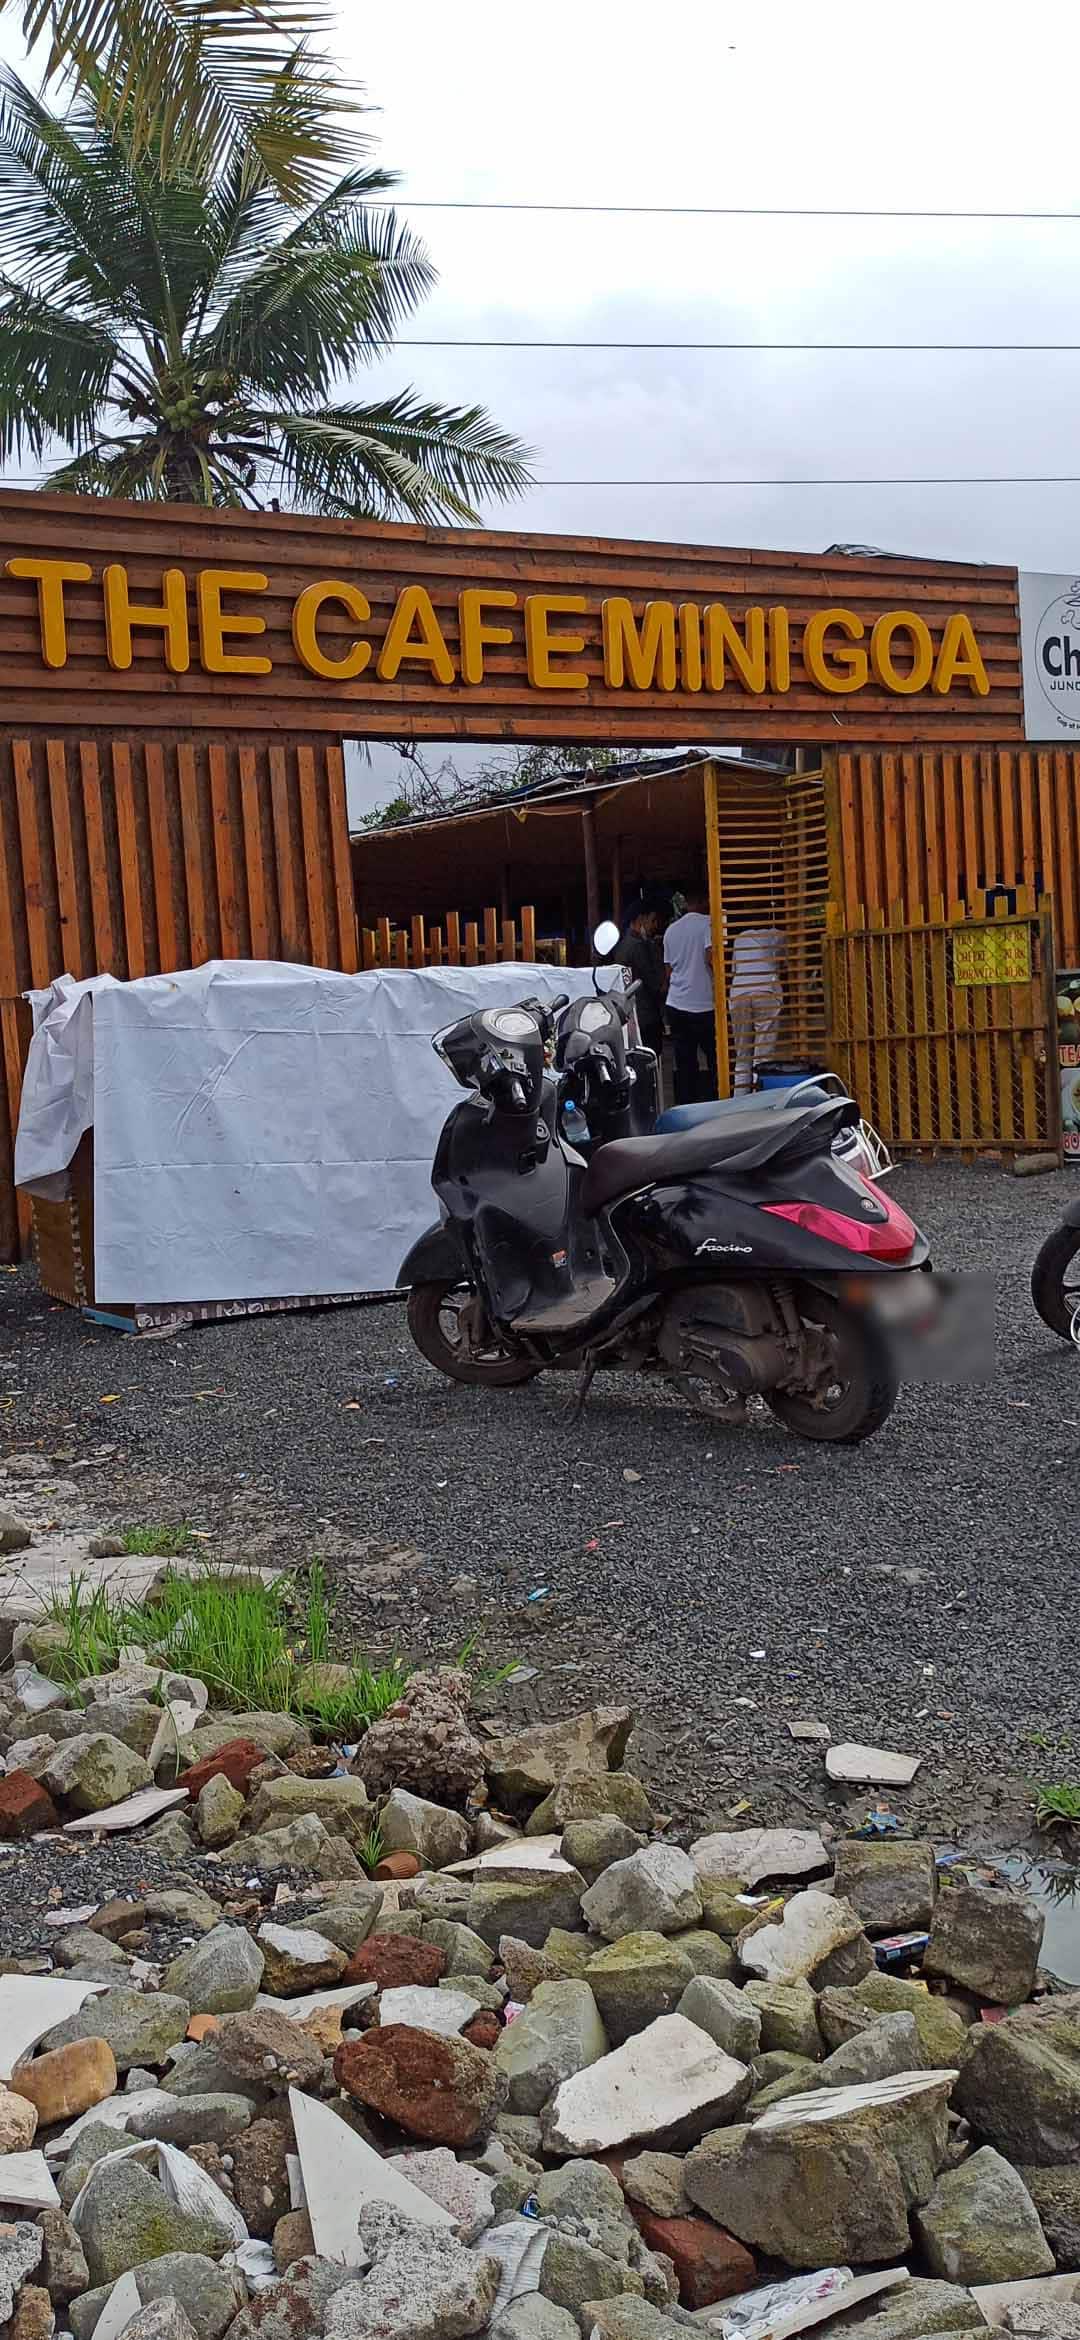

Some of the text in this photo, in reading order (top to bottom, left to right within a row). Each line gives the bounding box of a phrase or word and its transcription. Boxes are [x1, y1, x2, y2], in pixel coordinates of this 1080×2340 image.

[5, 558, 990, 696] THE CAFE MINI GOA
[1042, 635, 1080, 677] Ch
